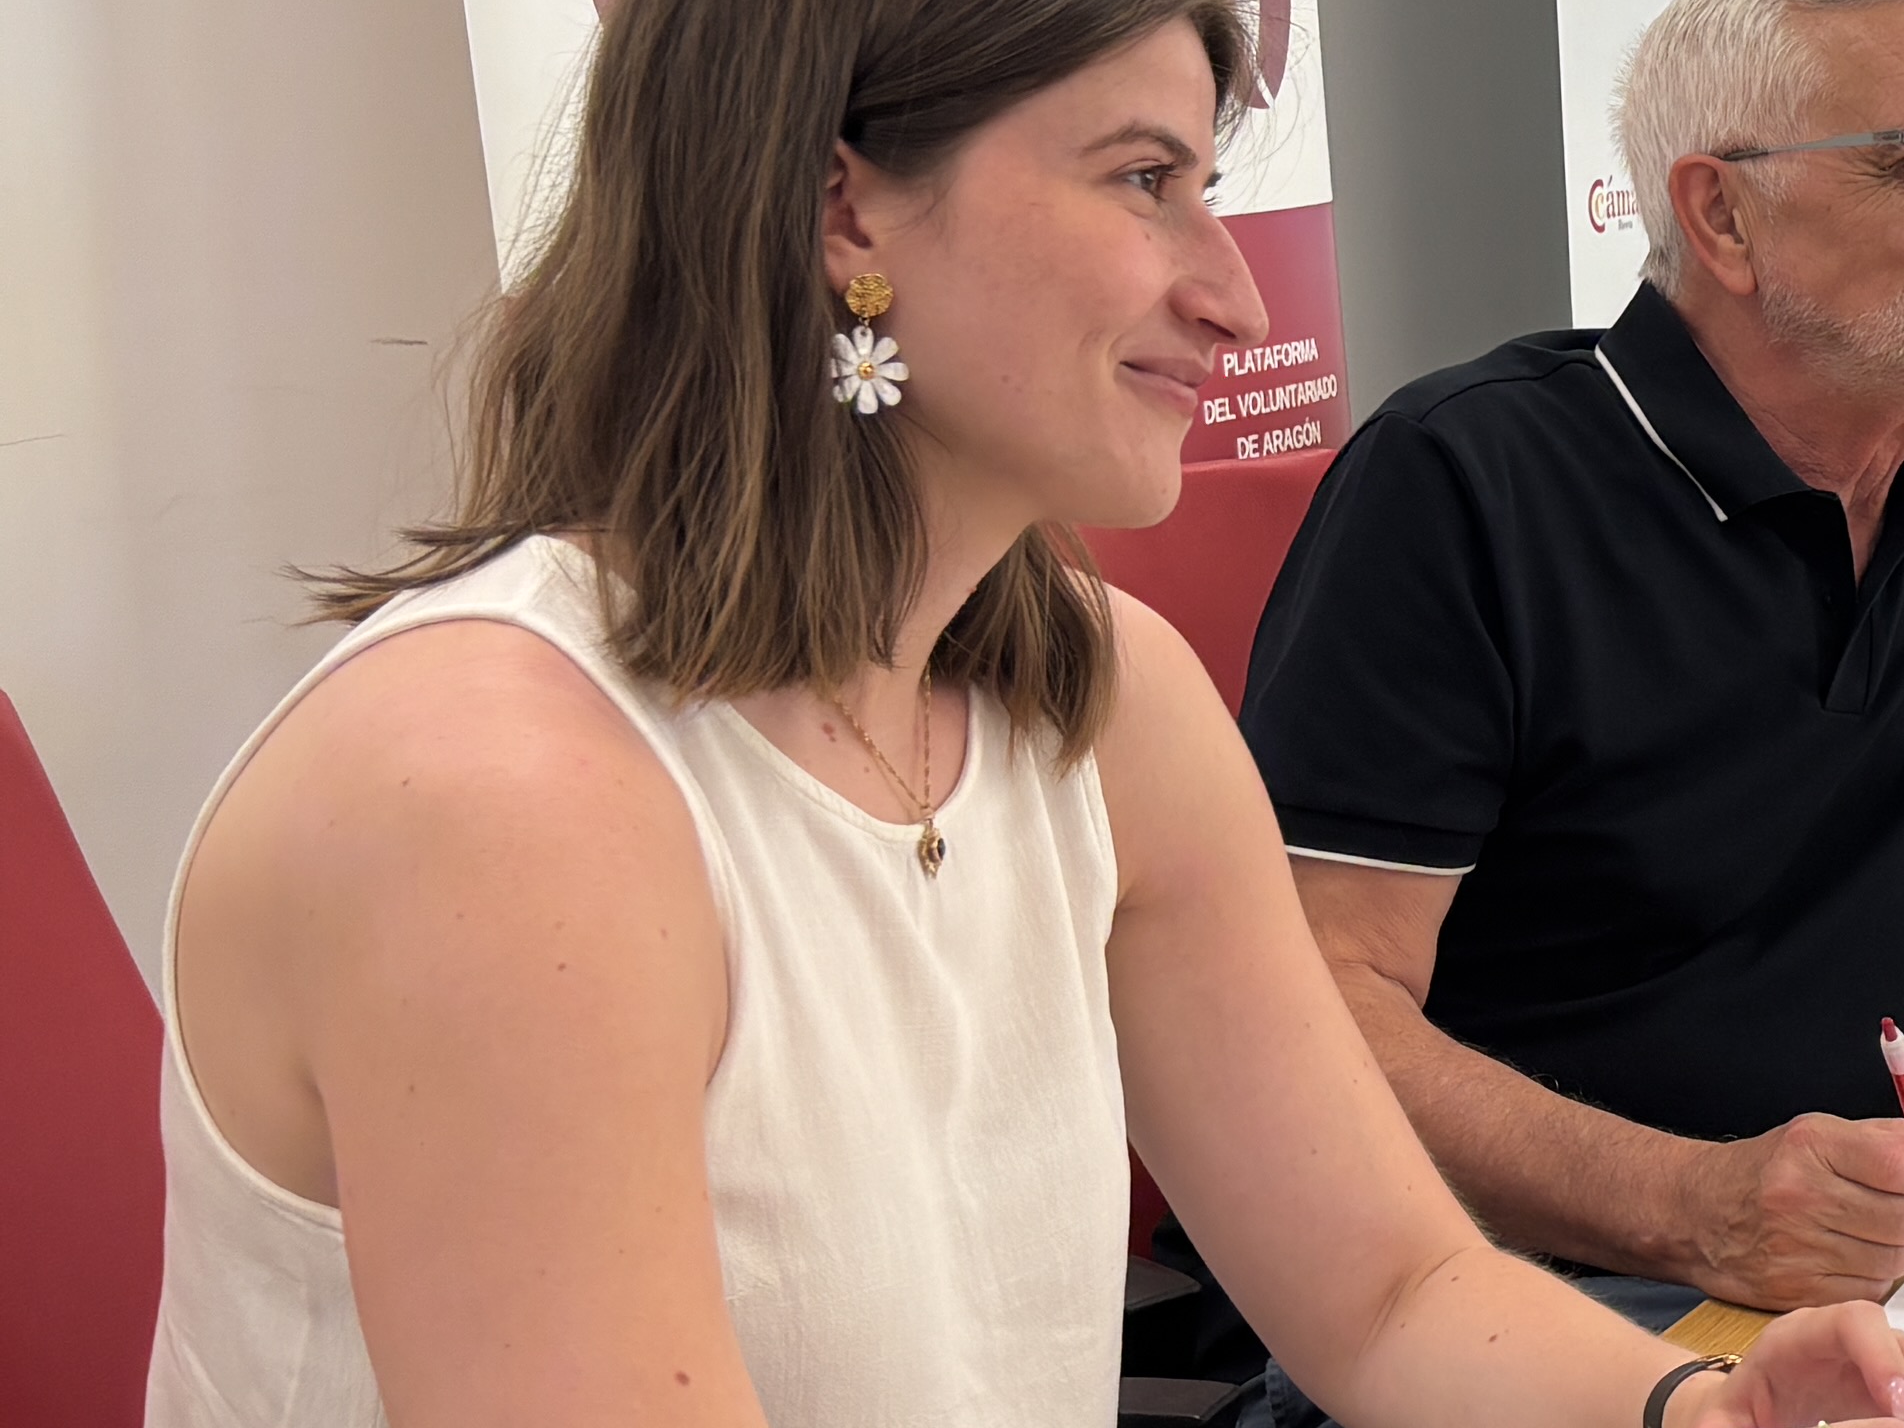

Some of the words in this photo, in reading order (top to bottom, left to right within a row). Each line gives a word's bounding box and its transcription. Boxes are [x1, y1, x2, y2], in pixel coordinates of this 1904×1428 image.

[1222, 337, 1319, 378] PLATAFORMA
[1203, 396, 1237, 425] DEL
[1236, 373, 1338, 418] VOLUNTARIADO
[1236, 433, 1260, 460] DE
[1262, 416, 1322, 457] ARAGÓN
